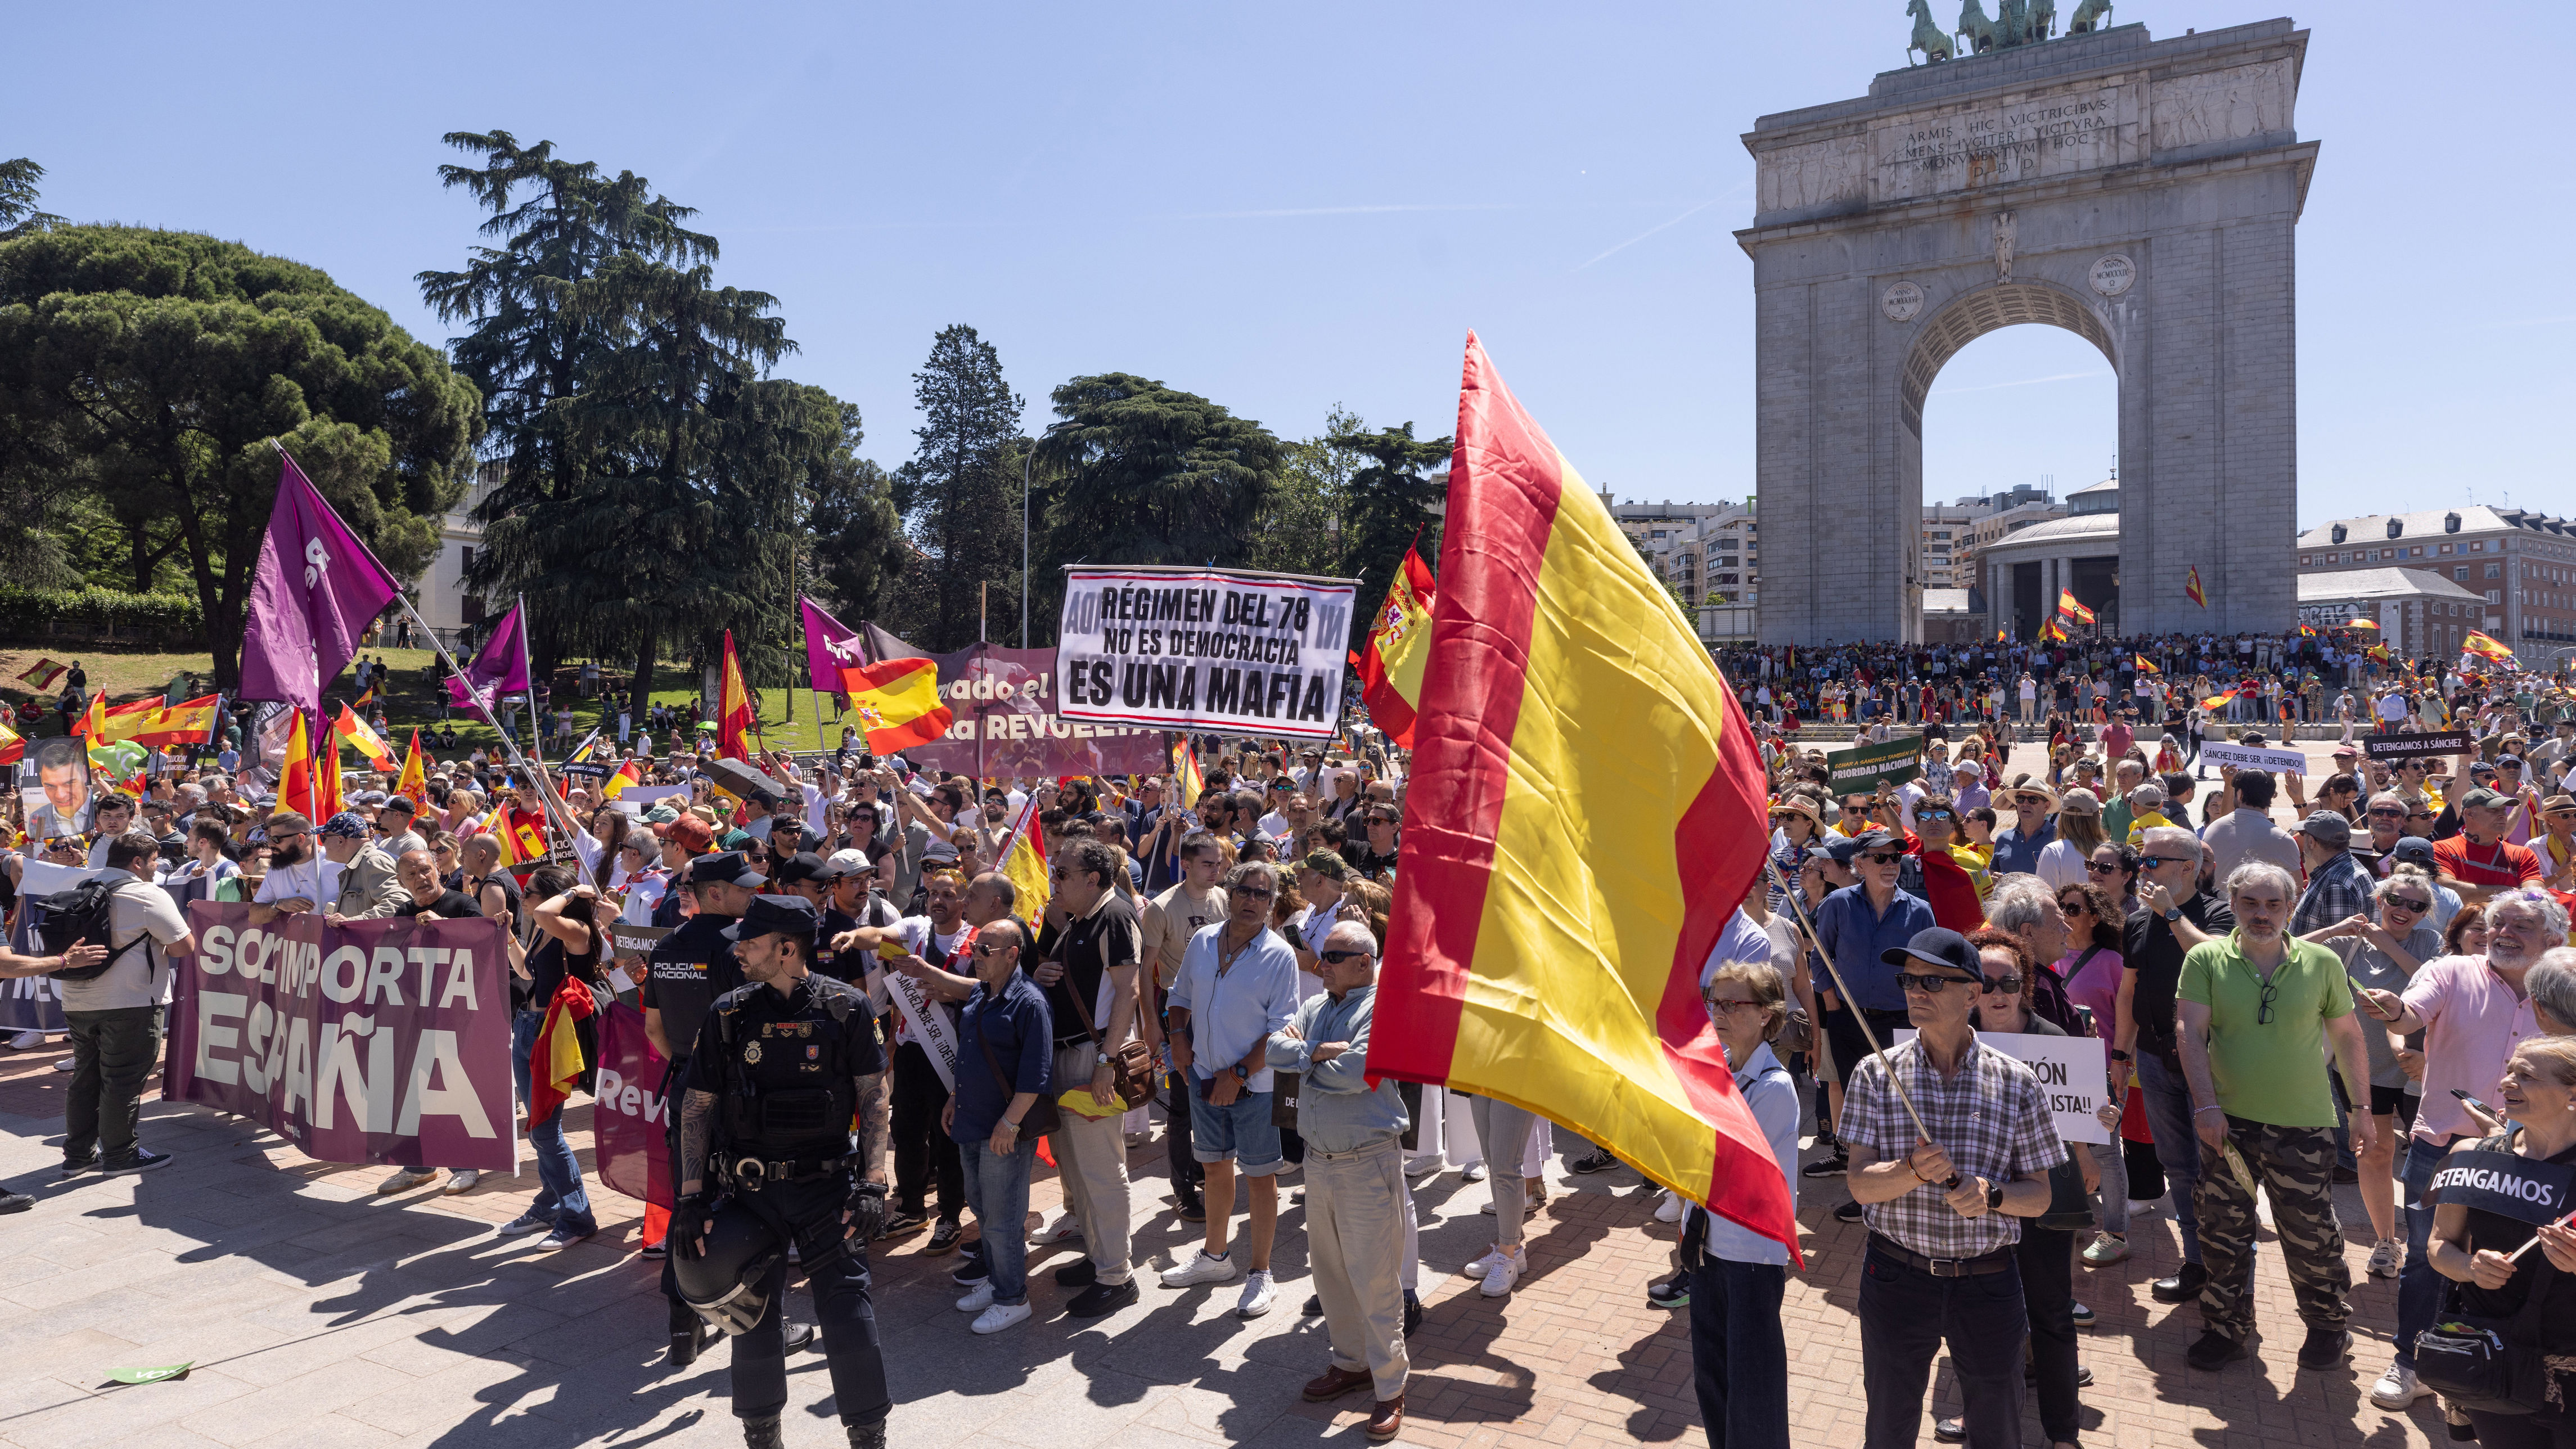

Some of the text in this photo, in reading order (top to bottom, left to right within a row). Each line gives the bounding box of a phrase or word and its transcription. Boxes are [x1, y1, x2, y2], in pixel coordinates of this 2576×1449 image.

[1906, 143, 1944, 159] MENS
[2034, 116, 2106, 136] VICTVRA
[1907, 100, 2106, 142] ARMIS HIC VICTRICIBVS
[1923, 134, 2088, 170] MONVMENTVM HOC
[2097, 268, 2128, 280] MCMXXXIX
[1889, 296, 1917, 306] MCMXXXVI
[1101, 581, 1217, 622] RÉGIMEN
[1222, 590, 1269, 628] DEL
[1276, 596, 1310, 632] 78
[1104, 628, 1299, 666] NO ES DEMOCRACIA
[1022, 672, 1048, 699] el
[1069, 660, 1325, 723] ES UNA MAFIA
[1860, 755, 1887, 766] SÁNCHEZ
[1888, 750, 1909, 760] TAMBIÉN
[2204, 748, 2303, 768] SÁNCHEZ DEBE SER, ¡¡DETENIDO!!
[2373, 741, 2422, 752] DETENGAMOS
[2430, 737, 2462, 748] SÁNCHEZ
[1832, 756, 1915, 780] PRIORIDAD NACIONAL
[615, 934, 657, 951] DETENGAMOS
[280, 938, 479, 1011] IMPORTA
[654, 971, 707, 979] NACIONAL
[896, 974, 924, 1009] SÁNCHEZ
[915, 1005, 934, 1027] DEBE
[926, 1024, 942, 1043] SER,
[194, 989, 498, 1139] ESPAÑA
[2227, 1144, 2250, 1186] VOX
[2430, 1167, 2554, 1206] DETENGAMOS
[136, 1366, 183, 1379] VOX
